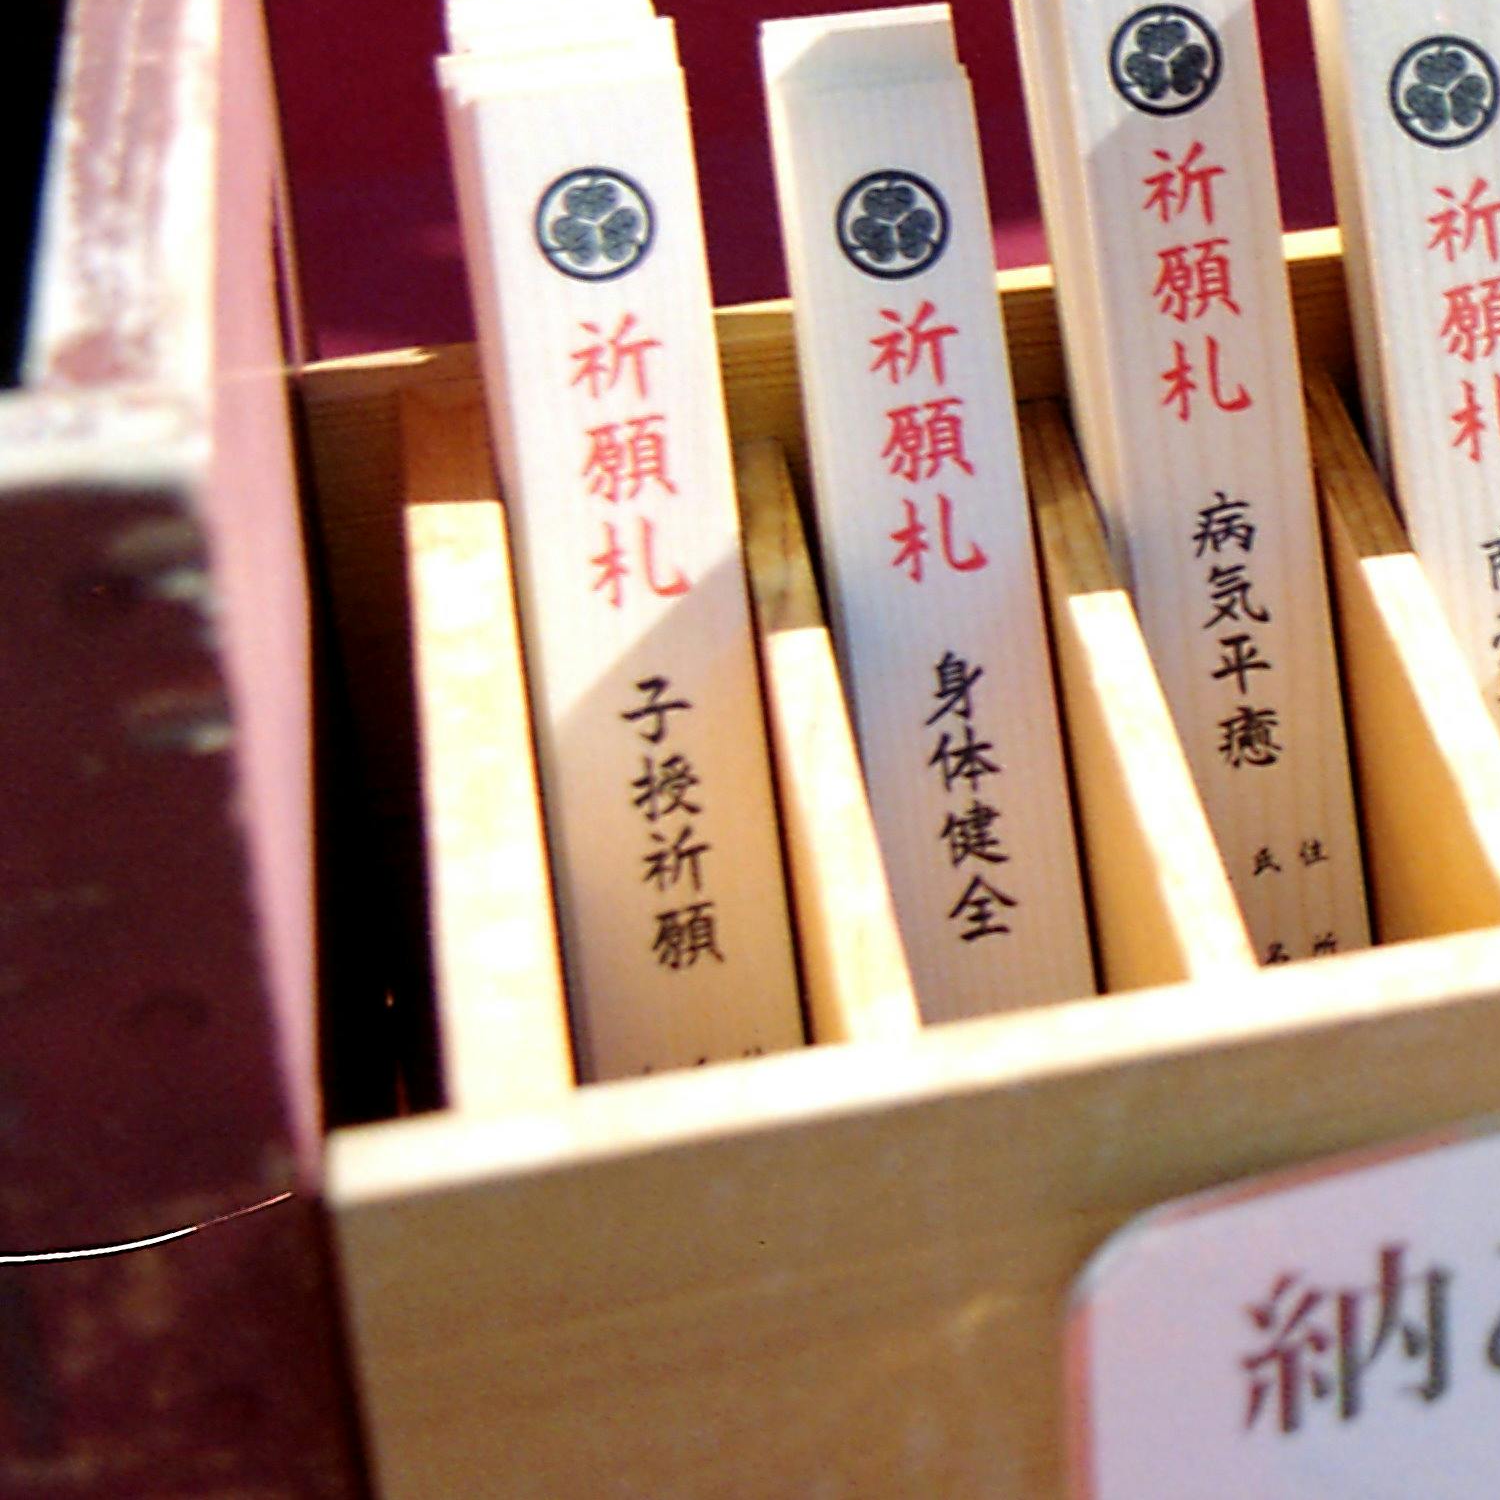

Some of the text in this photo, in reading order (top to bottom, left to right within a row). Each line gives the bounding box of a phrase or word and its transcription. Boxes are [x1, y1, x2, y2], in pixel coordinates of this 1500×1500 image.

[567, 311, 691, 611] 祈願札
[870, 301, 1017, 943] 祈願札 身体健全
[1141, 141, 1282, 769] 祈願札 病気平癒
[622, 675, 725, 971] 子授祈願
